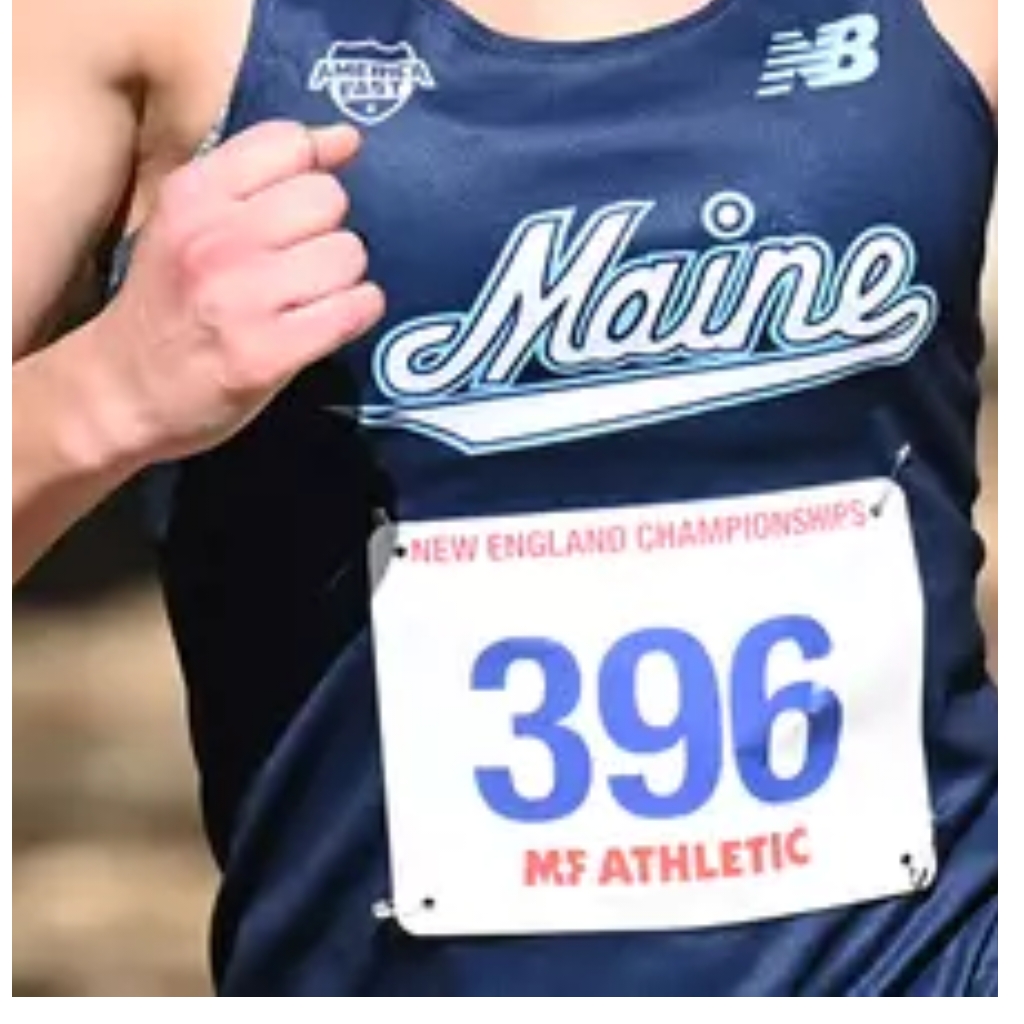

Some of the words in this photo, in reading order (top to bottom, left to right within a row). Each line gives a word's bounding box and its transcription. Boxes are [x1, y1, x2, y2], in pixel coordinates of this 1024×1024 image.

[313, 60, 432, 85] AMERICA
[338, 80, 401, 98] EAST
[374, 191, 938, 399] Maine
[410, 535, 479, 564] NEW
[486, 523, 626, 562] ENGLAND
[635, 498, 867, 552] CHAMPIONSHIPS
[470, 614, 844, 824] 396
[597, 822, 810, 886] ATHLETIC
